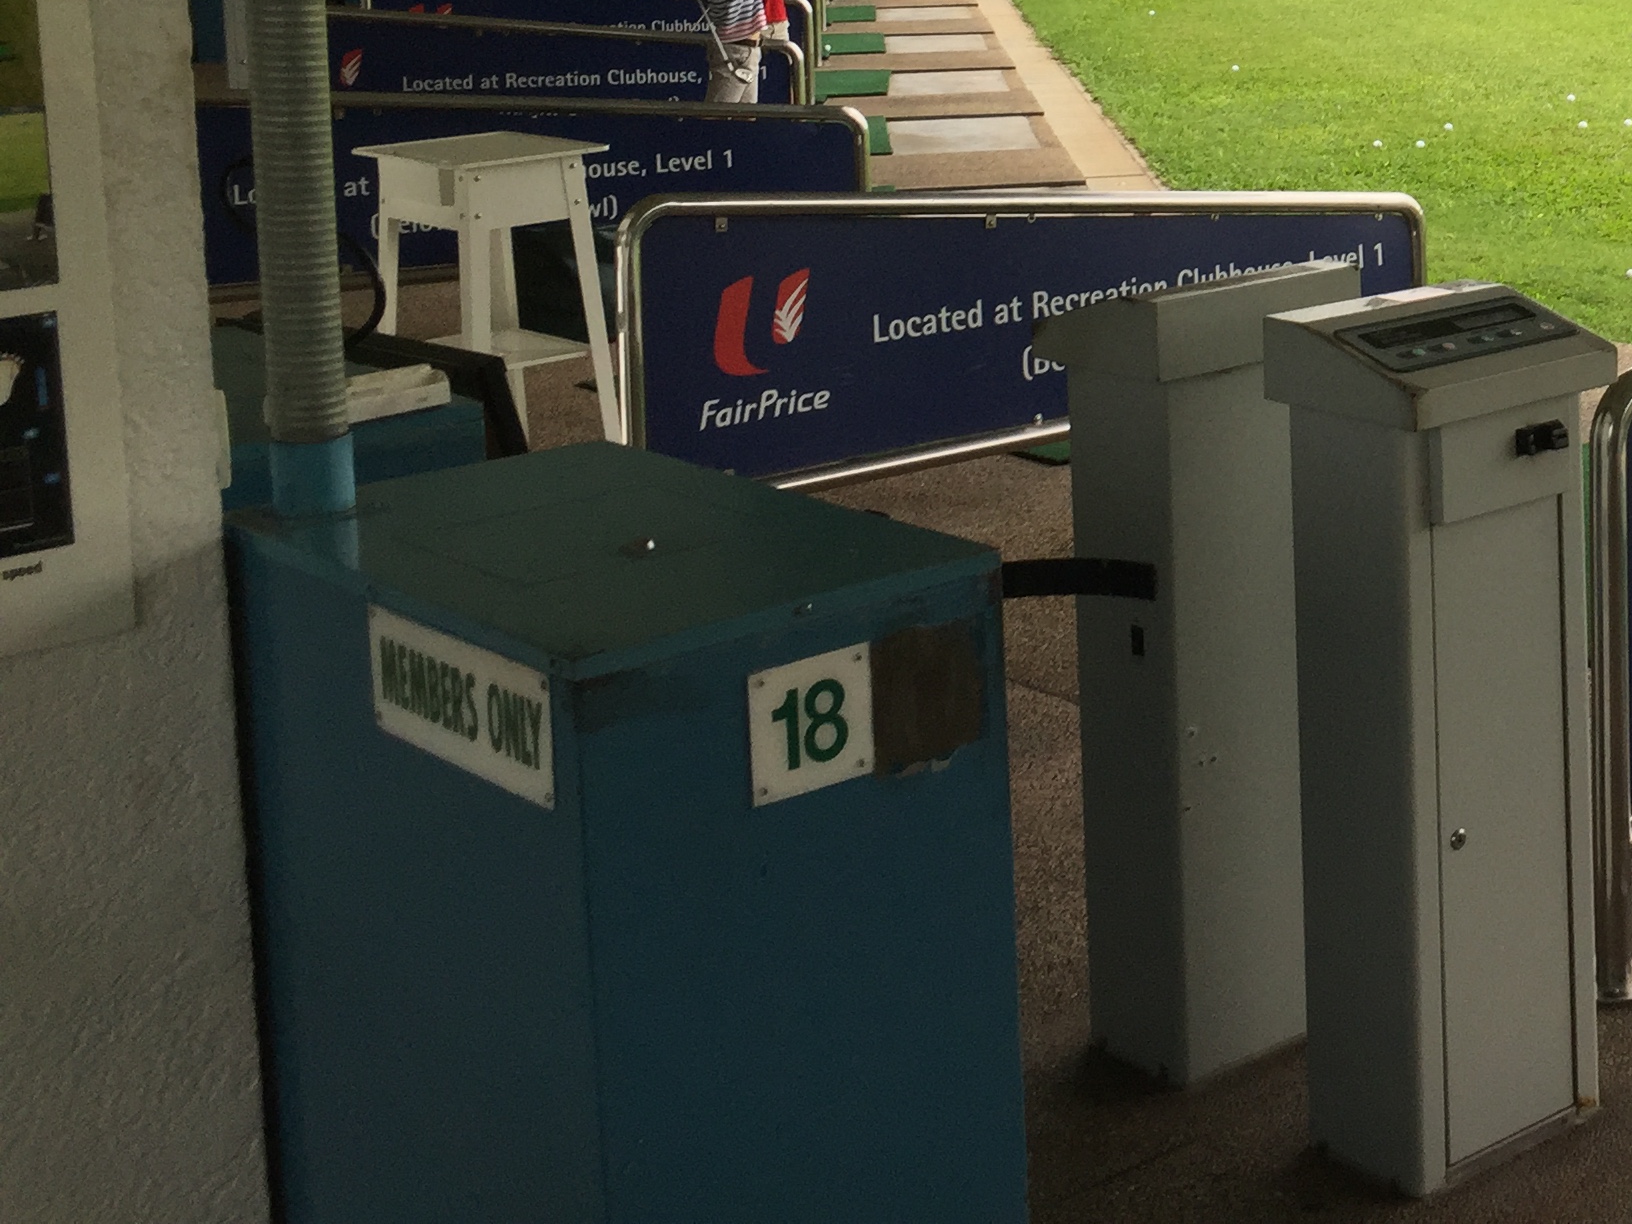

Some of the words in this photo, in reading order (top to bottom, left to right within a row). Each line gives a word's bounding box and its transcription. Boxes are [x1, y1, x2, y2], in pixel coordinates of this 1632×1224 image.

[403, 74, 473, 92] Located
[481, 74, 498, 89] at
[505, 71, 600, 88] Recreation
[608, 68, 702, 85] Clubhouse,
[344, 177, 370, 197] at
[656, 149, 713, 173] Level
[723, 149, 733, 168] 1
[873, 299, 983, 344] Located
[994, 296, 1023, 325] at
[1373, 242, 1383, 267] 1
[699, 389, 831, 431] FairPrice
[379, 634, 479, 743] MEMBERS
[487, 682, 543, 771] ONLY
[771, 678, 849, 771] 18
